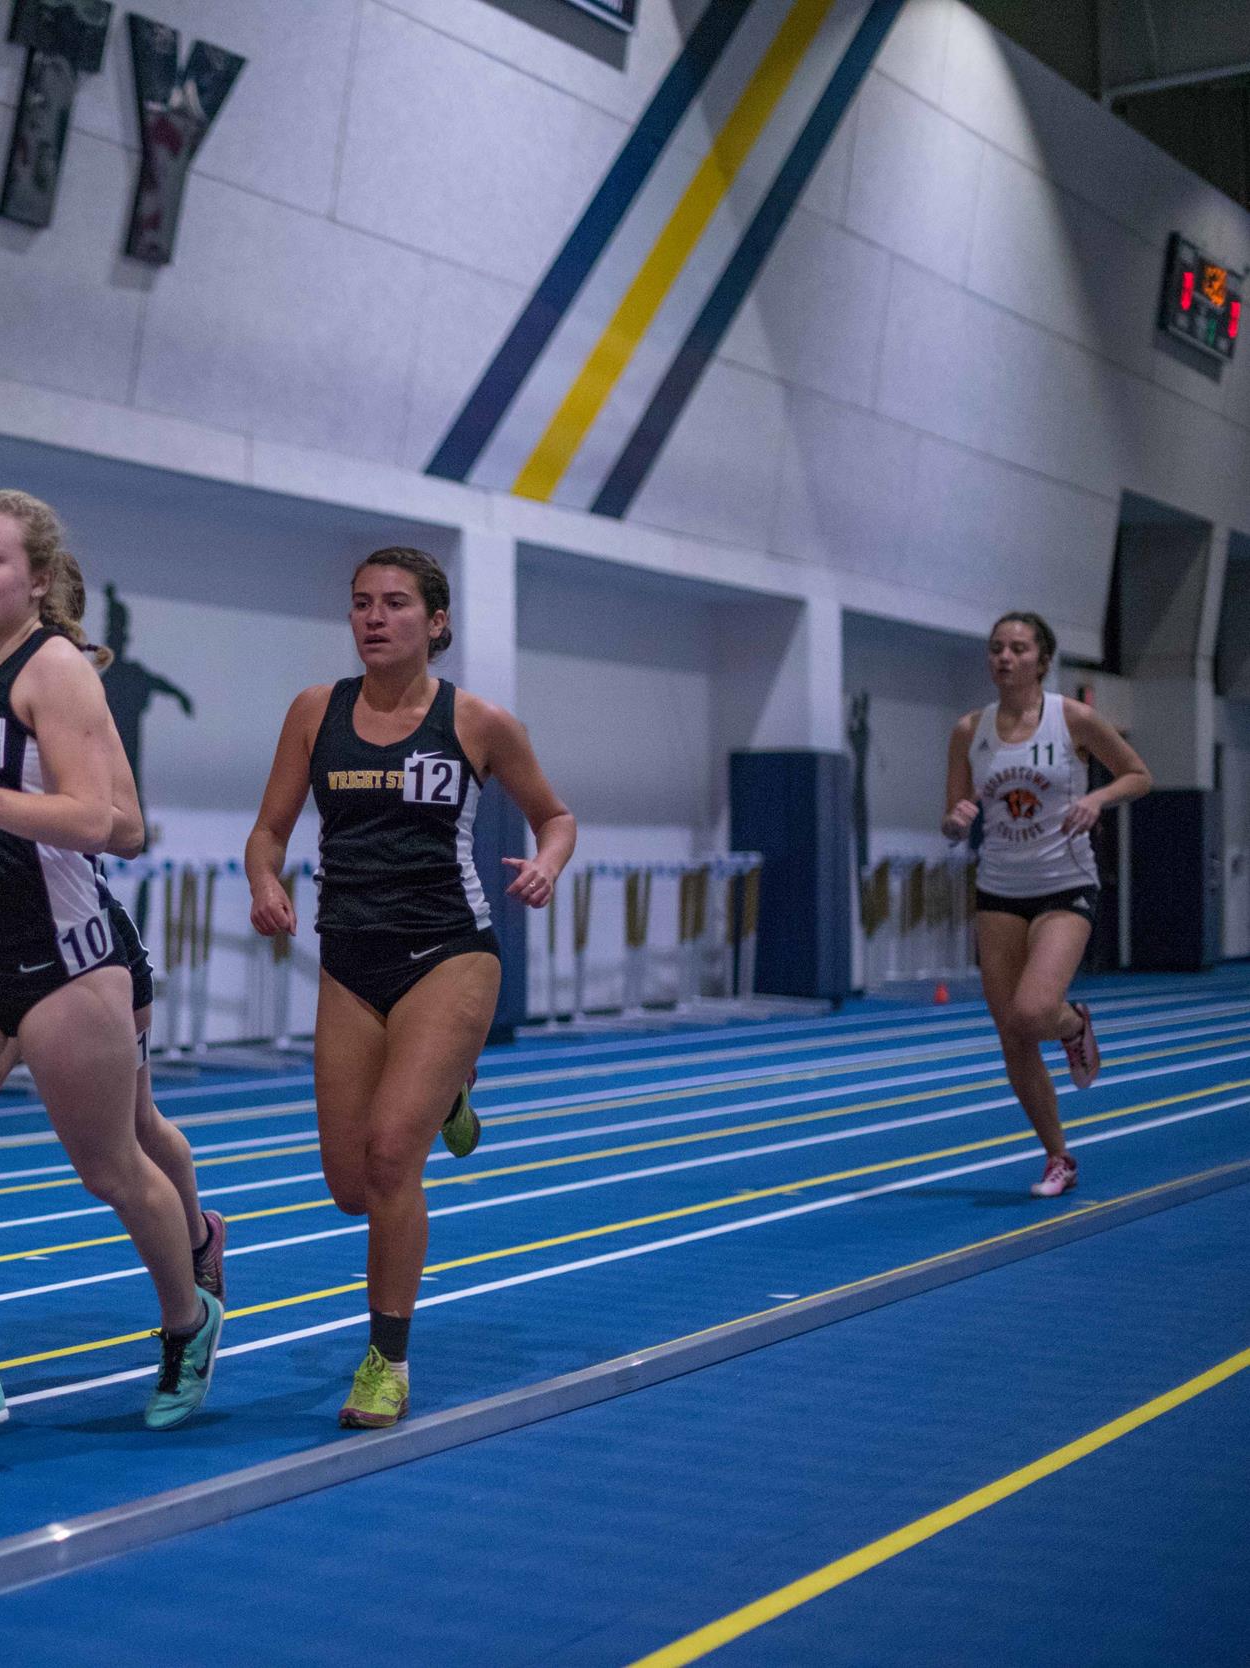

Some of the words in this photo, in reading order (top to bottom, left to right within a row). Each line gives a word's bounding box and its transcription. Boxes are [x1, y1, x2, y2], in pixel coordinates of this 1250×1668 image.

[1032, 743, 1054, 767] 11
[327, 770, 384, 790] WRIGHT
[409, 760, 453, 802] 12
[61, 915, 108, 970] 10
